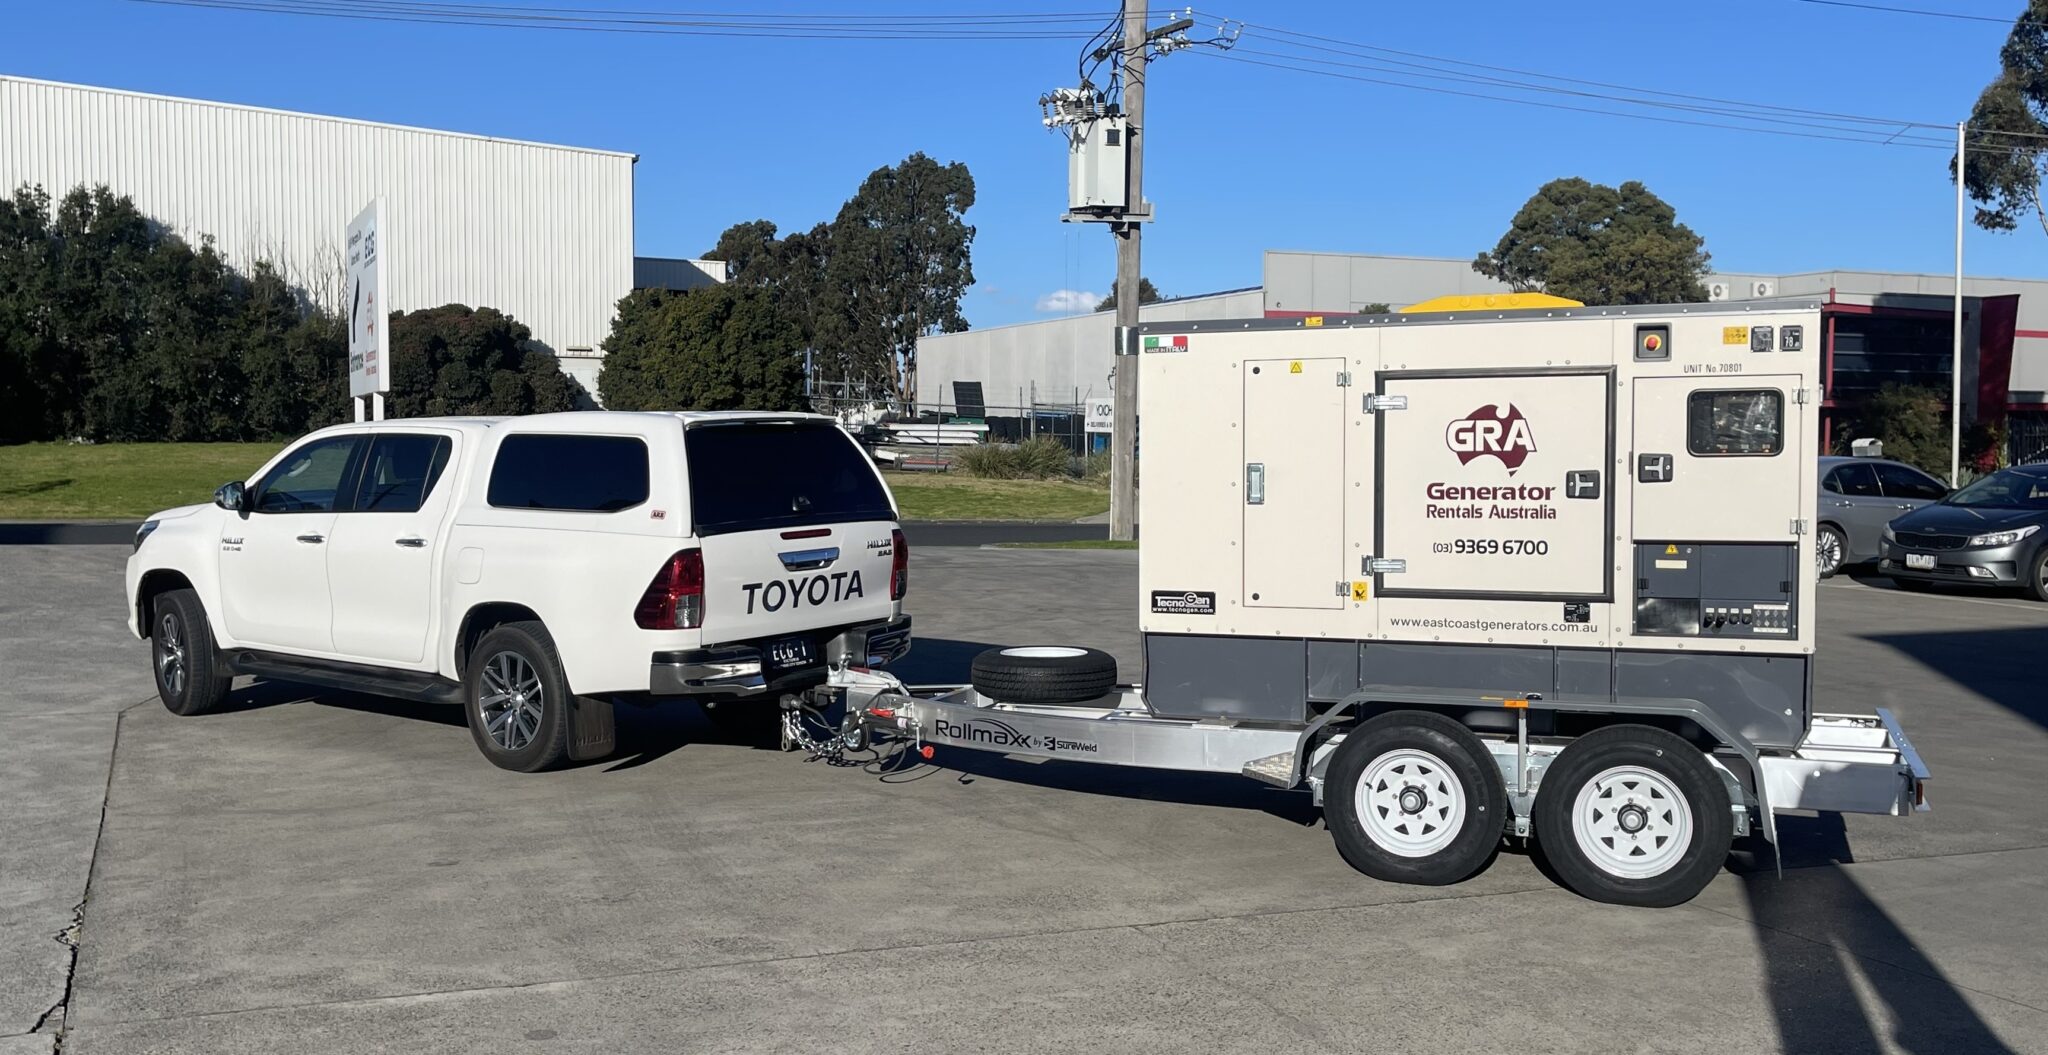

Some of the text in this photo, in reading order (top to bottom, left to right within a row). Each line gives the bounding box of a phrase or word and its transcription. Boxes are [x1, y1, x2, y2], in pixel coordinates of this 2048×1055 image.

[1683, 364, 1702, 374] UNIT
[1446, 418, 1537, 452] GRA
[1426, 482, 1556, 501] Generator
[1426, 504, 1556, 520] Rentals Australia
[1432, 539, 1549, 556] (03) 9369 6700
[742, 570, 863, 615] TOYOTA
[1155, 592, 1210, 608] TecnoGen
[1390, 615, 1598, 634] www.eastcoastgenerators.com.au
[935, 717, 1032, 749] Rollmaxx
[1033, 737, 1042, 748] by
[1056, 740, 1098, 753] SureWeld
